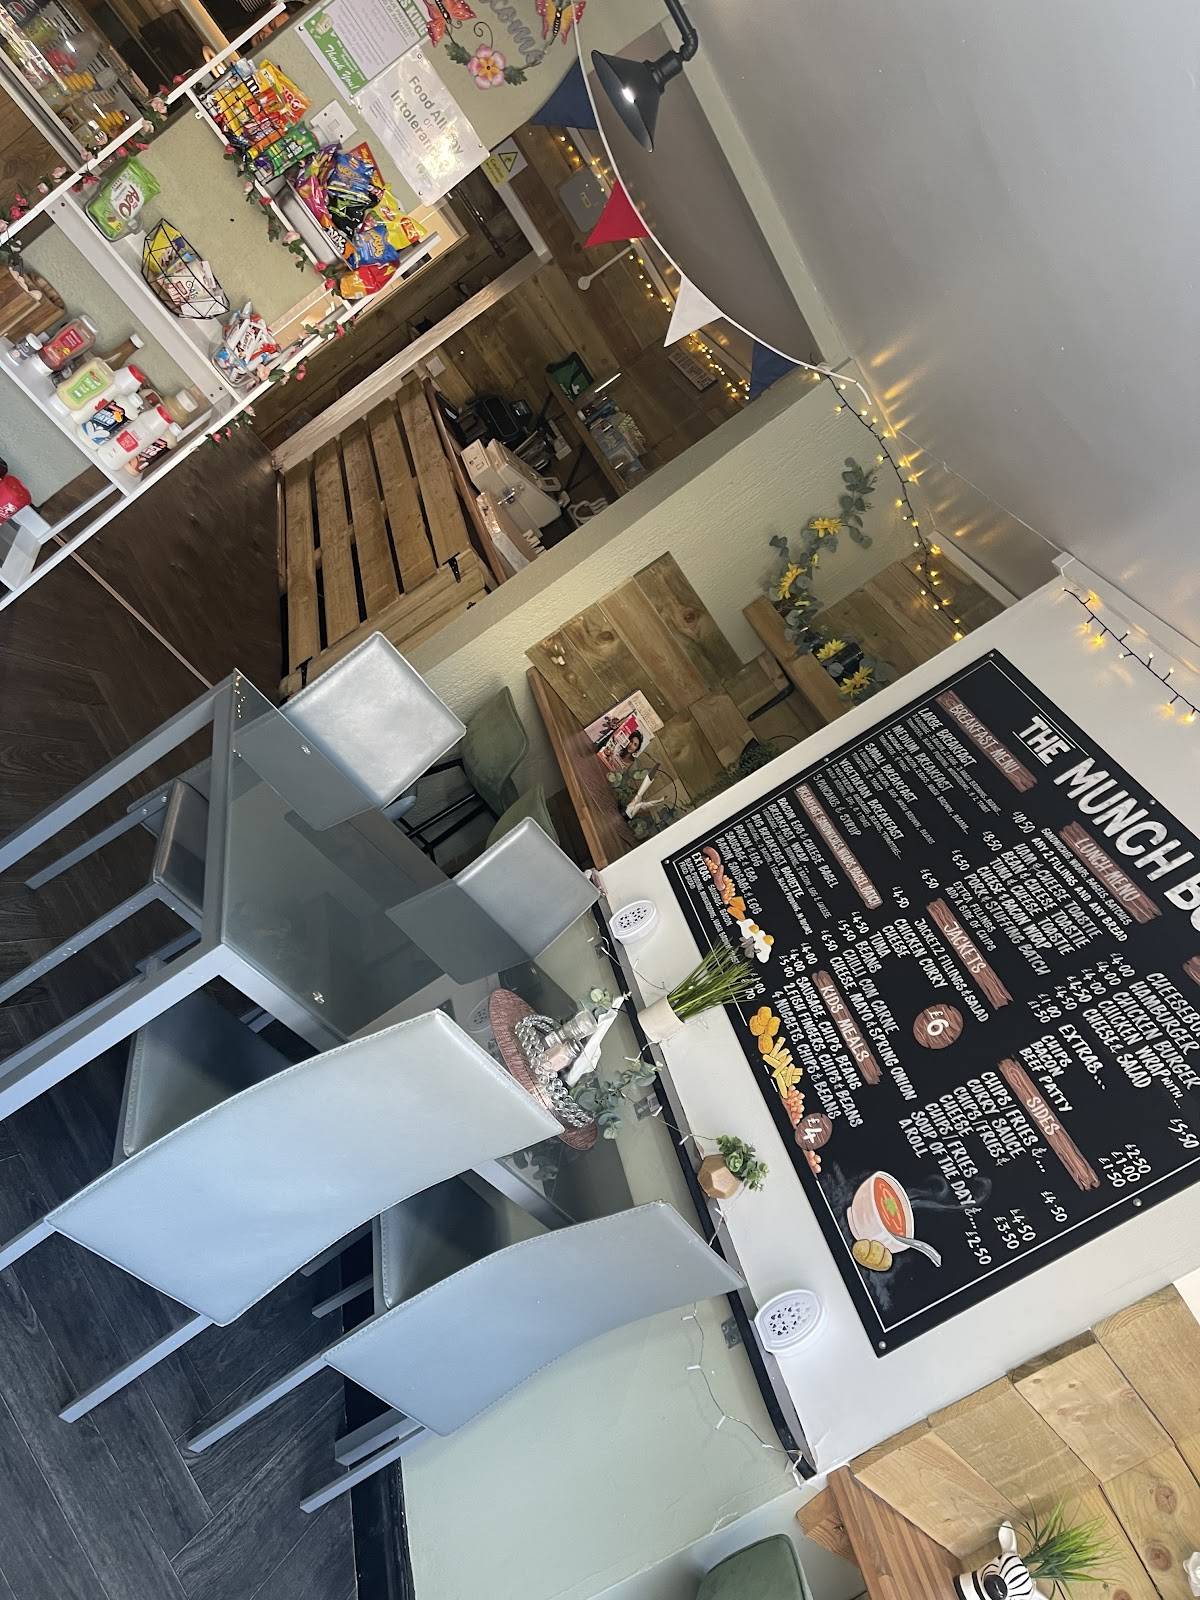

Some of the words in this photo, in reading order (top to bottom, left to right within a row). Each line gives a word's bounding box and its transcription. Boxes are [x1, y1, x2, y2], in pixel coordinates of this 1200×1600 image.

[406, 5, 429, 36] KING
[323, 44, 346, 71] Thank
[340, 69, 360, 92] You!
[408, 75, 435, 110] Food
[422, 117, 434, 130] or
[917, 707, 944, 731] LARGE
[935, 728, 977, 768] BREAKFAST
[948, 703, 999, 750] BREAKFAST
[989, 747, 1020, 775] MENU
[812, 773, 823, 781] 3
[864, 742, 887, 765] SMALL
[880, 763, 918, 804] BREAKFAST
[891, 724, 920, 754] MEDIUM
[914, 752, 954, 792] BREAKFAST
[815, 778, 841, 808] PANCAKES
[838, 757, 873, 799] VEGETARIAN
[866, 798, 905, 841] BREAKFAST
[1012, 715, 1071, 767] THE
[1052, 756, 1195, 882] MUNCH
[767, 803, 796, 841] BREAKFAST
[790, 841, 809, 862] WRAP
[776, 796, 797, 820] BACON
[790, 819, 806, 835] EGG
[802, 838, 825, 865] CHEESE
[817, 864, 839, 889] BAGEL
[839, 813, 862, 837] SYRUP
[1031, 837, 1049, 852] ANY
[724, 830, 748, 862] SAUSAGE
[743, 866, 758, 883] EGG
[733, 823, 753, 849] BACON
[748, 851, 764, 867] EGG
[751, 813, 765, 828] BIG
[758, 826, 787, 867] BREAKFAST
[780, 865, 805, 899] BAGUETTE
[1042, 850, 1055, 859] 2
[691, 851, 712, 882] EXTRAS
[1048, 856, 1079, 887] FILLINGS
[1073, 837, 1113, 872] LUNCH
[1103, 869, 1141, 902] MENU
[727, 860, 752, 894] SAUSAGE
[746, 897, 763, 915] EGG
[859, 884, 882, 907] BATCH
[944, 886, 959, 899] ADD
[952, 880, 973, 904] EXTRA
[969, 902, 996, 933] FILLINGS
[989, 856, 1013, 881] TUNA
[1010, 884, 1043, 917] CHEESE
[1037, 916, 1076, 956] TOASTIE
[1000, 850, 1028, 875] BEAN
[1023, 877, 1058, 912] CHEESE
[1050, 908, 1091, 949] TOASTIE
[1012, 842, 1038, 866] HAM
[1035, 869, 1072, 903] CHEESE
[1063, 899, 1103, 940] TOASTIE
[1073, 885, 1092, 902] AND
[958, 904, 975, 921] SIDE
[963, 872, 990, 899] PORK
[984, 900, 1026, 945] STUFFING
[1017, 942, 1051, 977] BATCH
[969, 919, 982, 929] OF
[976, 865, 1007, 895] CHEESE
[1001, 897, 1032, 926] BACON
[1022, 923, 1052, 950] WRAP
[1088, 901, 1107, 918] ANY
[1104, 898, 1133, 926] BATCHES
[868, 930, 892, 959] TUNA
[881, 924, 911, 959] CHEESE
[943, 920, 987, 974] JACKETS
[975, 929, 997, 952] CHIPS
[1101, 916, 1128, 942] BREAD
[854, 939, 882, 974] BEANS
[893, 917, 928, 958] CHICKEN
[918, 957, 948, 989] CURRY
[782, 981, 796, 993] 2
[786, 989, 807, 1013] FISH
[841, 948, 867, 978] CHILLI
[858, 977, 880, 999] CON
[870, 999, 900, 1036] CARNE
[937, 953, 968, 991] FILLINGS
[964, 994, 989, 1023] SALAD
[820, 984, 844, 1014] KIDS
[837, 1017, 870, 1063] MEALS
[924, 1009, 950, 1037] £6
[1128, 980, 1200, 1056] HAMBURGER
[771, 990, 784, 999] 4
[796, 1042, 820, 1074] CHIPS
[813, 1080, 842, 1123] BEANS
[848, 991, 875, 1022] MAYO
[868, 1026, 900, 1067] SPRING
[890, 1065, 918, 1102] ONION
[1040, 1034, 1073, 1068] CHIPS
[1081, 1007, 1120, 1047] CHEESE
[1115, 1052, 1152, 1089] SALAD
[1097, 999, 1144, 1046] CHICKEN
[1134, 1044, 1171, 1078] WRAP
[1112, 990, 1163, 1041] CHICKEN
[1152, 1039, 1200, 1091] BURGER
[817, 1052, 843, 1084] CHIPS
[834, 1053, 863, 1091] BEANS
[1030, 1040, 1064, 1078] BACON
[1018, 1046, 1046, 1073] BEEF
[1038, 1074, 1073, 1113] PATTY
[835, 1088, 864, 1128] BEANS
[898, 1117, 913, 1129] A
[910, 1109, 938, 1140] SOUP
[938, 1093, 974, 1138] CHEESE
[966, 1078, 1000, 1116] CURRY
[991, 1117, 1026, 1159] SAUCE
[1026, 1094, 1061, 1136] SIDES
[800, 1116, 824, 1145] £4
[904, 1126, 929, 1159] ROLL
[928, 1141, 948, 1157] OF
[937, 1154, 960, 1181] THE
[950, 1179, 976, 1207] DAY
